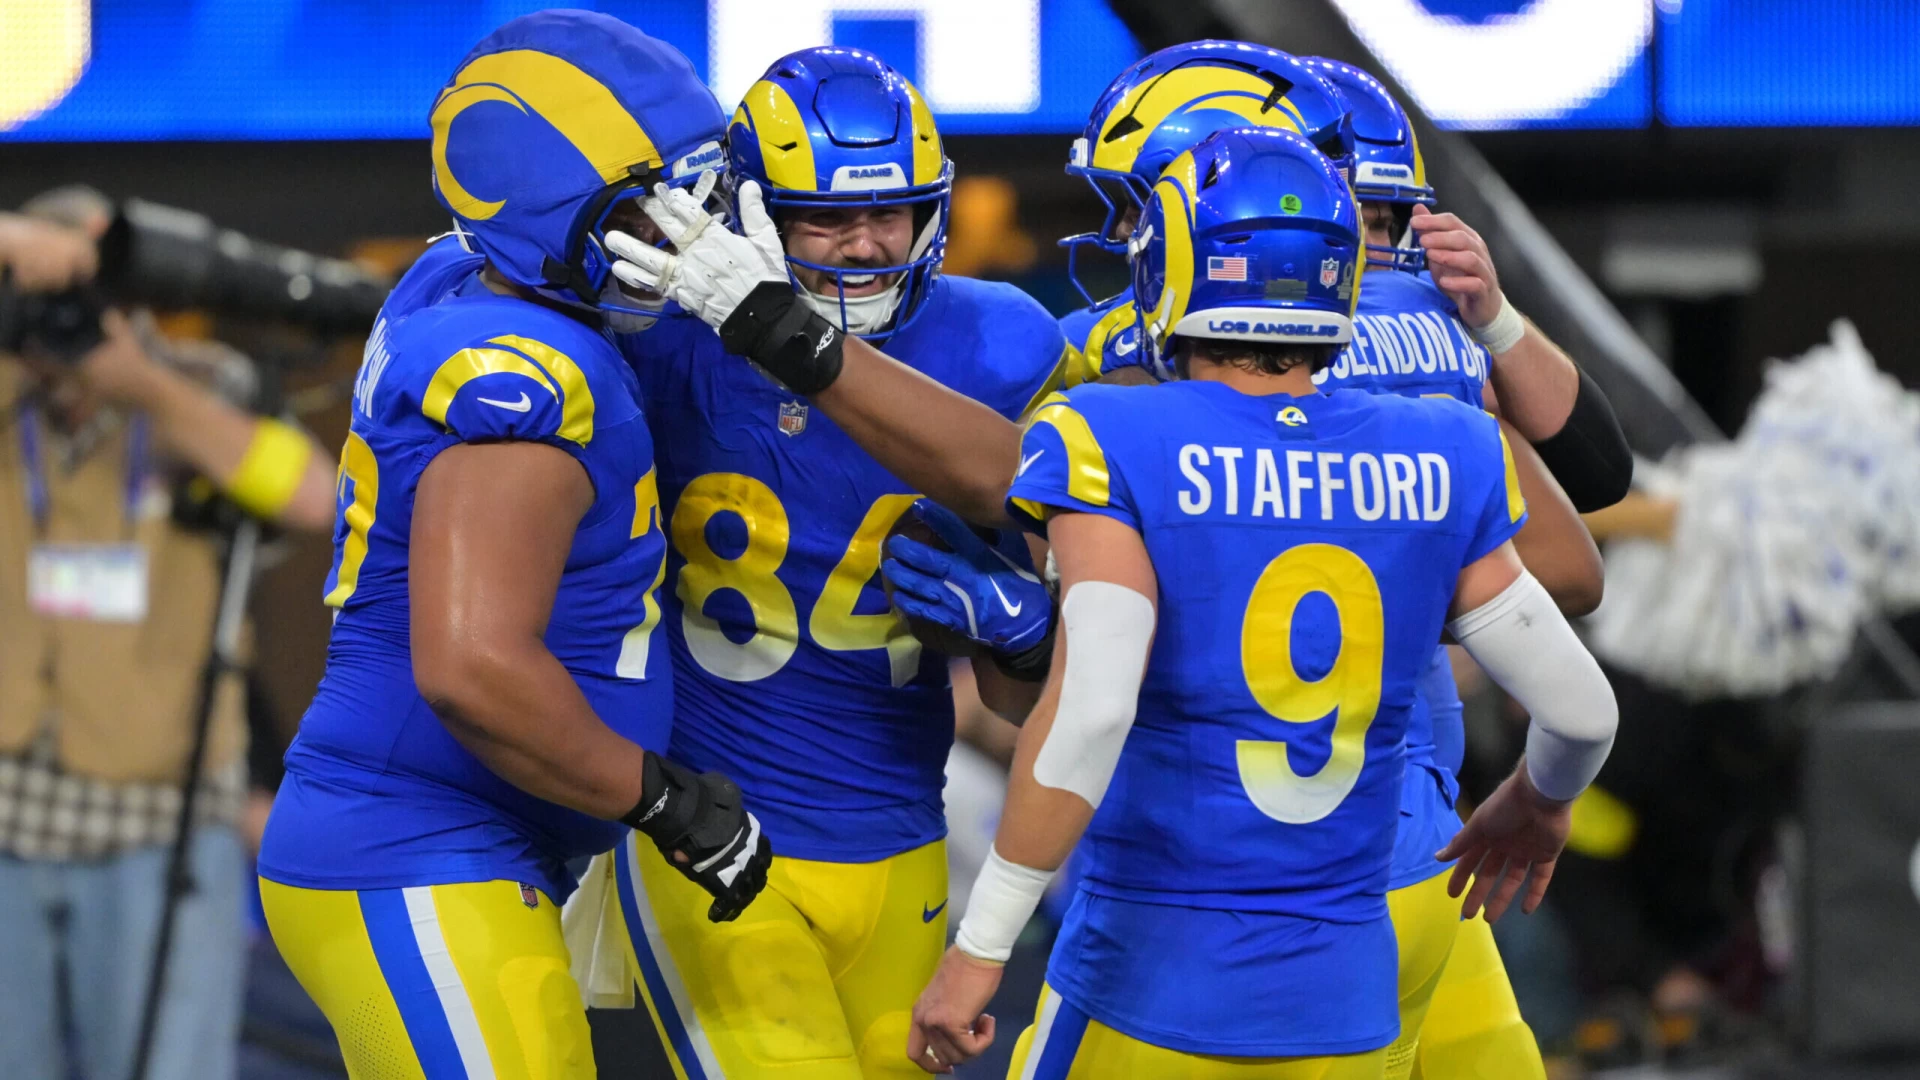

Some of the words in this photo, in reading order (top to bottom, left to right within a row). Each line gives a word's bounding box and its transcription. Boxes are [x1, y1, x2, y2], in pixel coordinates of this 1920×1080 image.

[685, 147, 722, 169] RAMS
[848, 167, 893, 179] RAMS
[1208, 320, 1249, 333] LOS
[1253, 322, 1340, 337] ANGELES
[782, 416, 804, 431] NFL
[1178, 444, 1451, 522] STAFFORD
[671, 472, 928, 688] 84
[1236, 543, 1385, 825] 9
